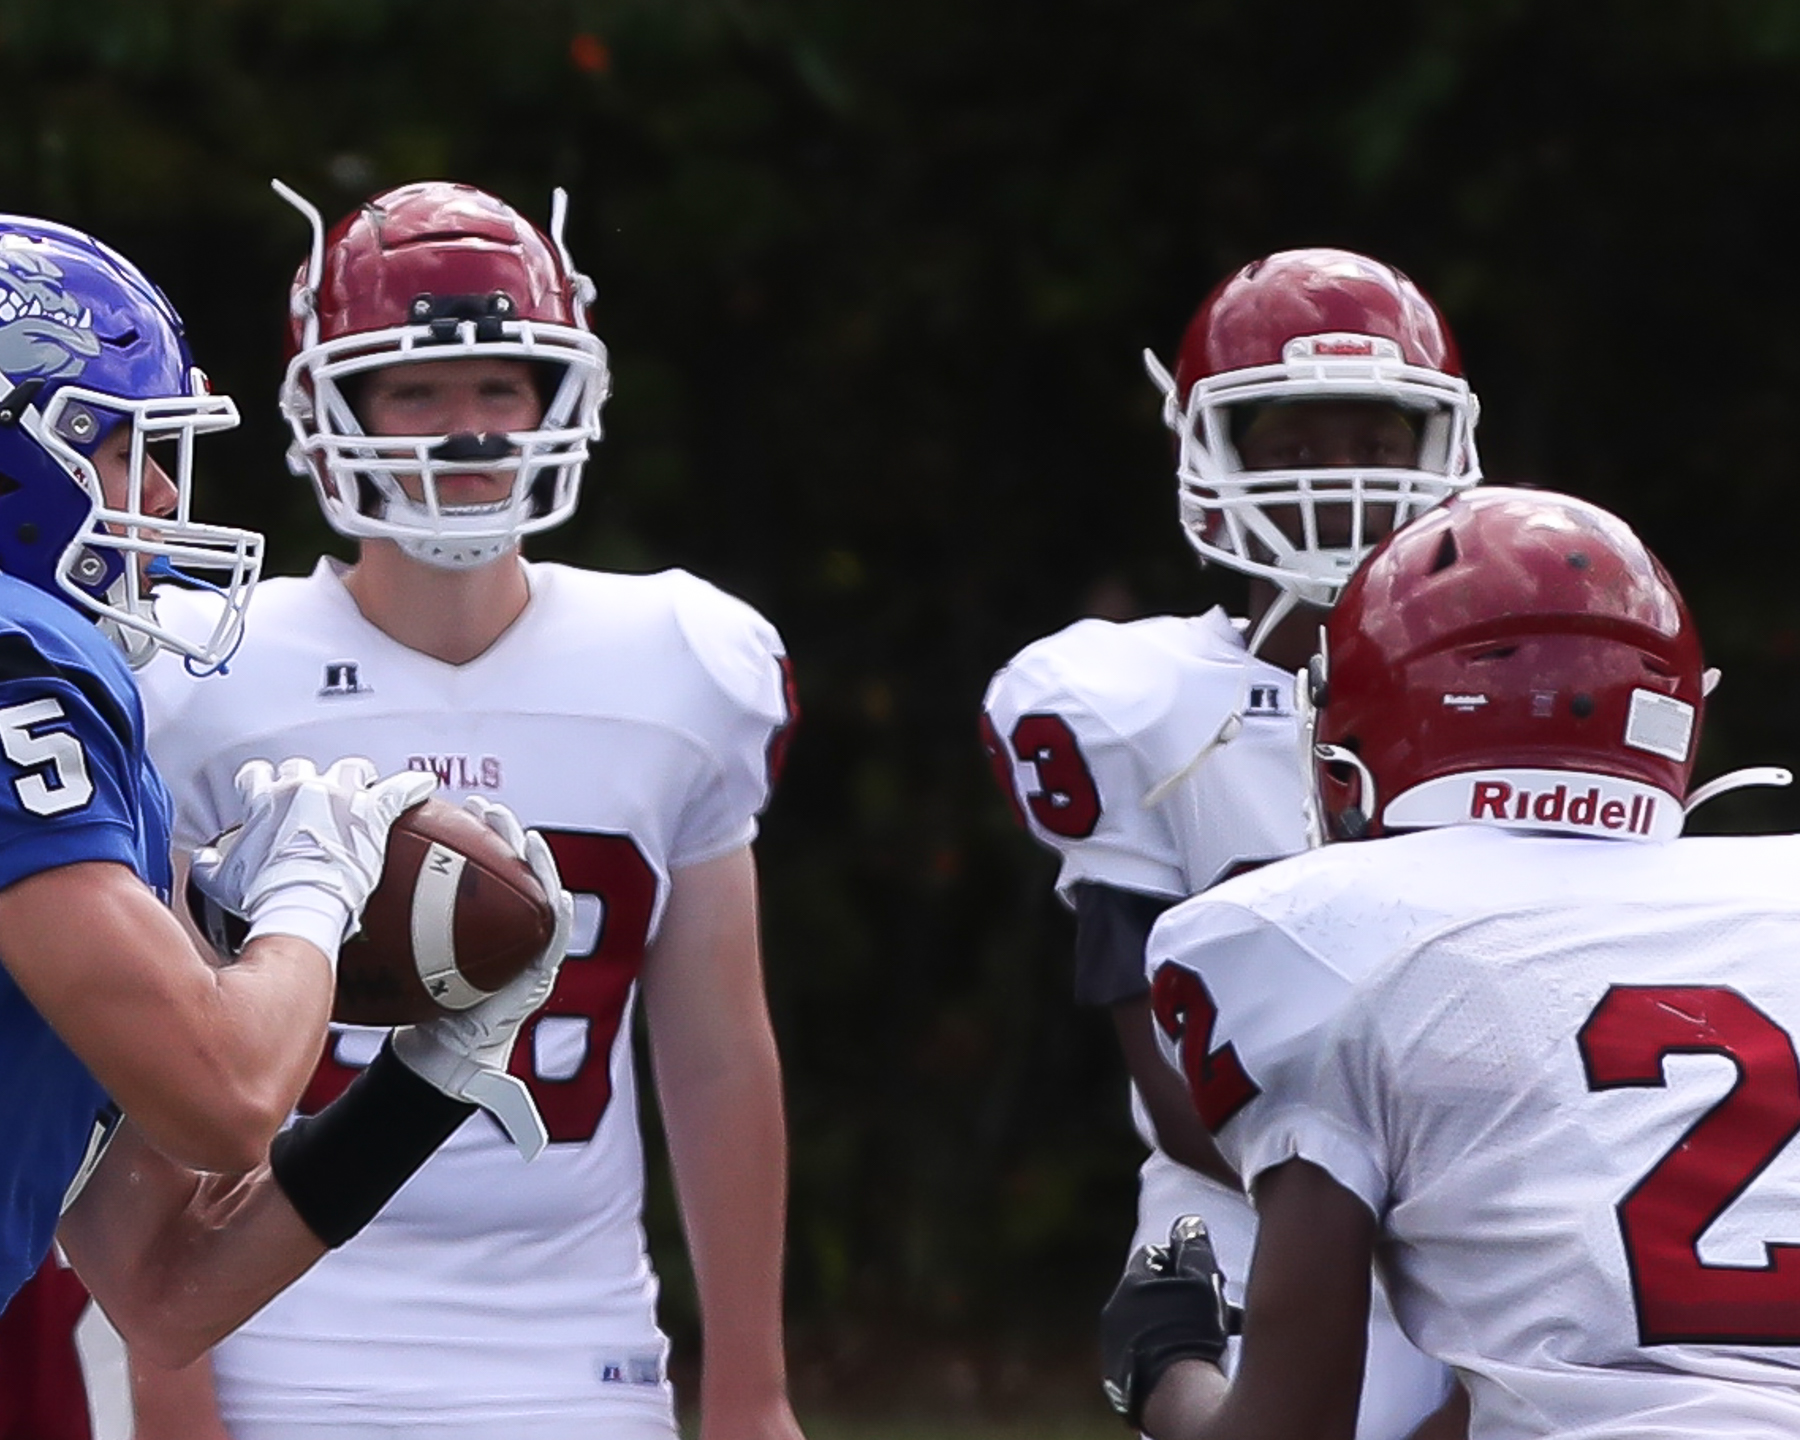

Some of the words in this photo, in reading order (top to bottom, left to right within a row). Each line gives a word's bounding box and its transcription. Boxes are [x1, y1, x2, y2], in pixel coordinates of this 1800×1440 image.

[1471, 780, 1657, 835] Riddell
[1151, 960, 1263, 1138] 2
[1576, 983, 1800, 1347] 2
